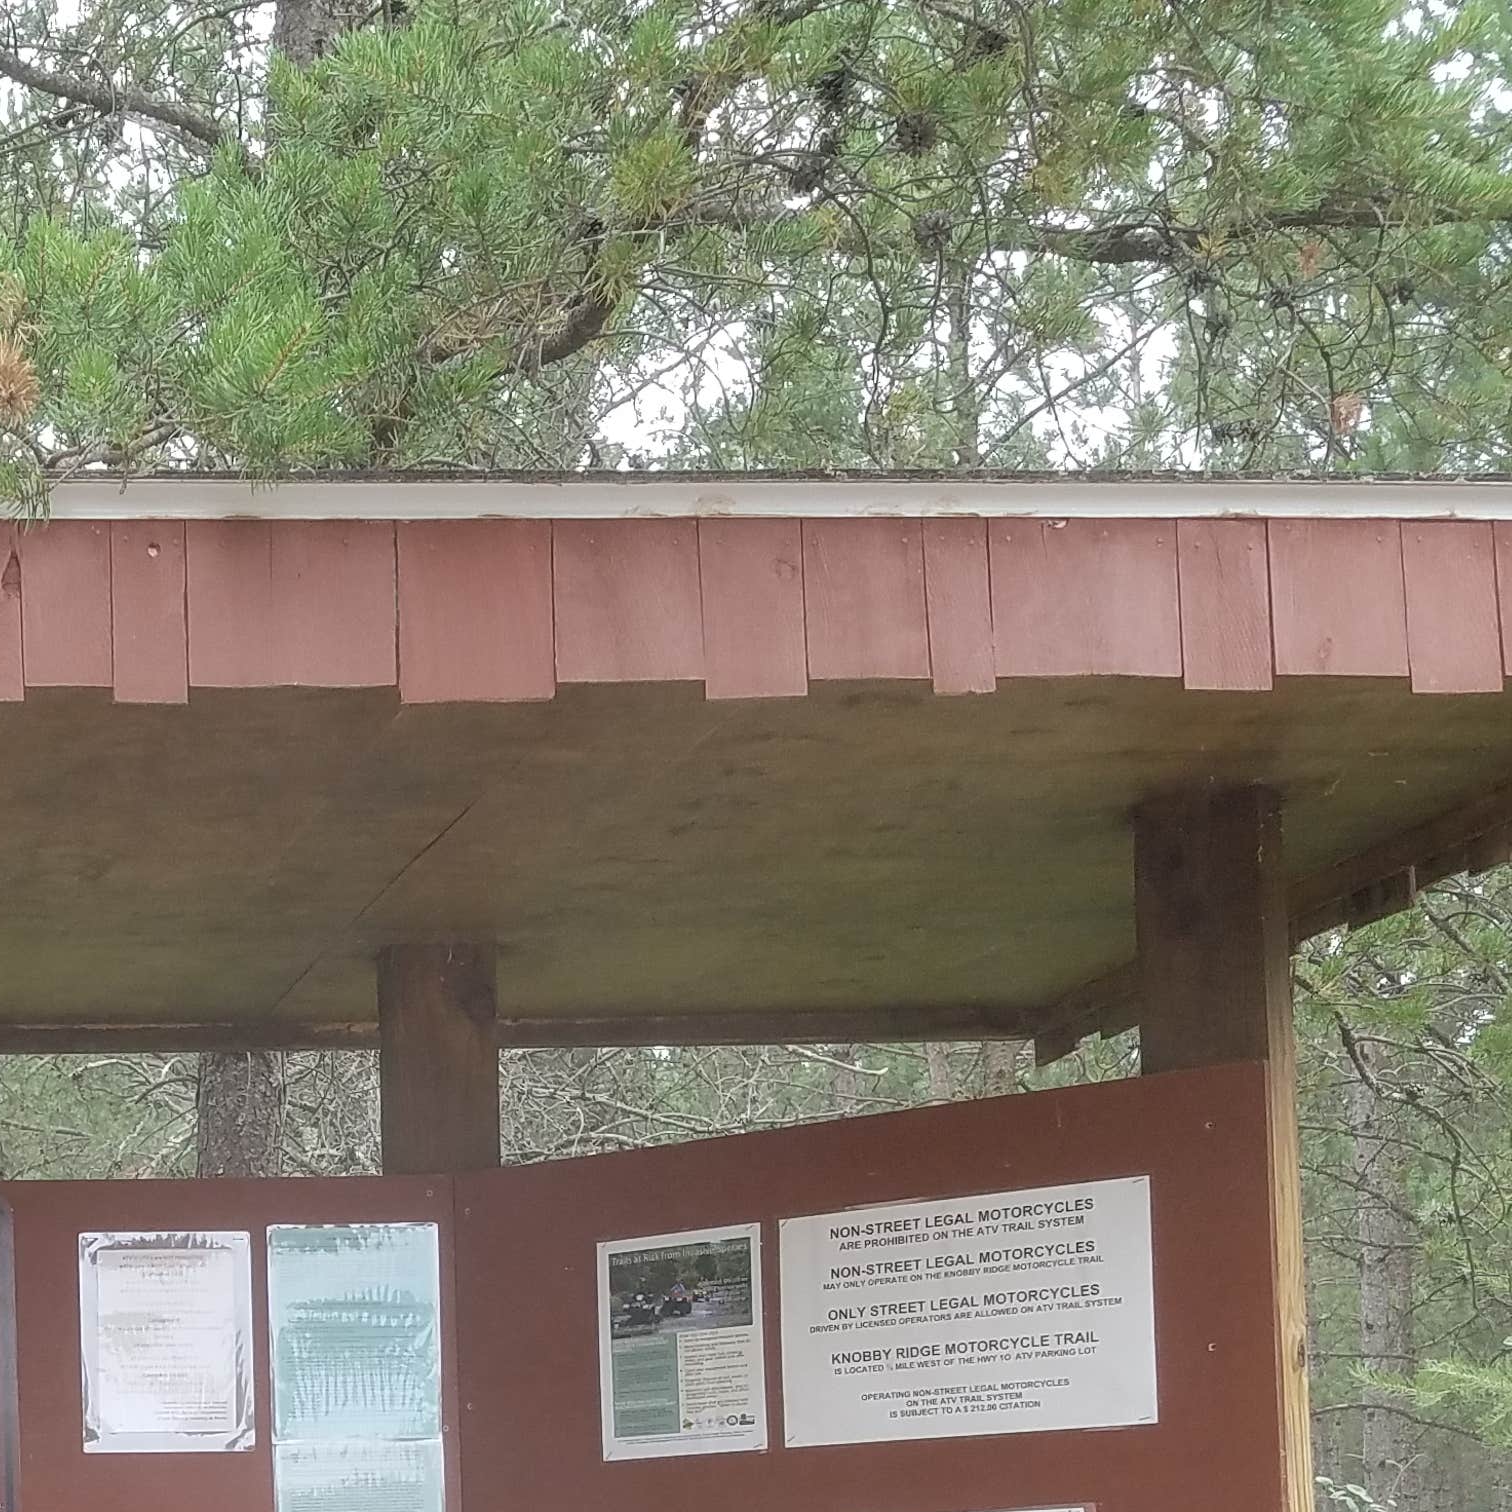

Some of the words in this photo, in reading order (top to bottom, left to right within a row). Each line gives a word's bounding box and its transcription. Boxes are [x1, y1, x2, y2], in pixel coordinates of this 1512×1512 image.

[829, 1217, 921, 1240] NON-STREET
[924, 1212, 974, 1228] LEGAL
[977, 1197, 1094, 1222] MOTORCYCLES
[838, 1239, 862, 1251] ARE
[863, 1232, 930, 1249] PROHIBITED
[931, 1229, 948, 1241] ON
[950, 1227, 974, 1238] THE
[975, 1224, 999, 1236] ATV
[1000, 1220, 1035, 1233] TRAIL
[1037, 1214, 1084, 1229] SYSTEM
[661, 1252, 681, 1260] from
[830, 1258, 922, 1279] NON-STREET
[925, 1253, 974, 1269] LEGAL
[978, 1240, 1095, 1263] MOTORCYCLES
[827, 1305, 866, 1321] ONLY
[869, 1300, 926, 1317] STREET
[929, 1295, 979, 1311] LEGAL
[983, 1283, 1100, 1306] MOTORCYCLES
[831, 1347, 892, 1365] KNOBBY
[895, 1343, 941, 1359] RIDGE
[944, 1334, 1050, 1355] MOTORCYCLE
[1053, 1330, 1099, 1345] TRAIL
